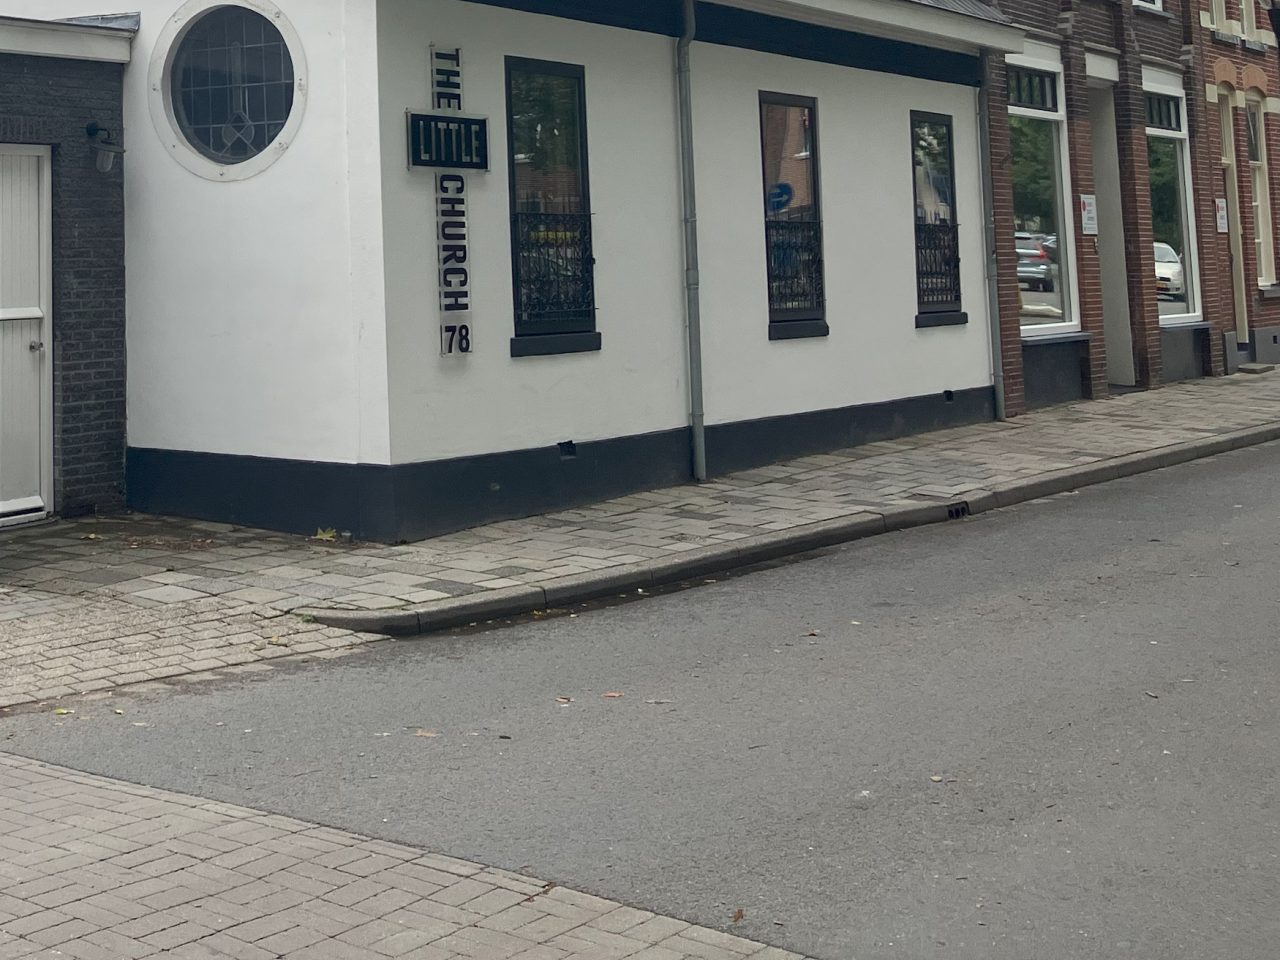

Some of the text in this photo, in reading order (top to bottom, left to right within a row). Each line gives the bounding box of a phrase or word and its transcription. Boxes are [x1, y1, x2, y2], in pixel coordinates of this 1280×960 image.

[435, 48, 462, 110] THE
[420, 120, 480, 162] LITTLE
[440, 174, 469, 312] CHURCH
[444, 325, 470, 353] 78
